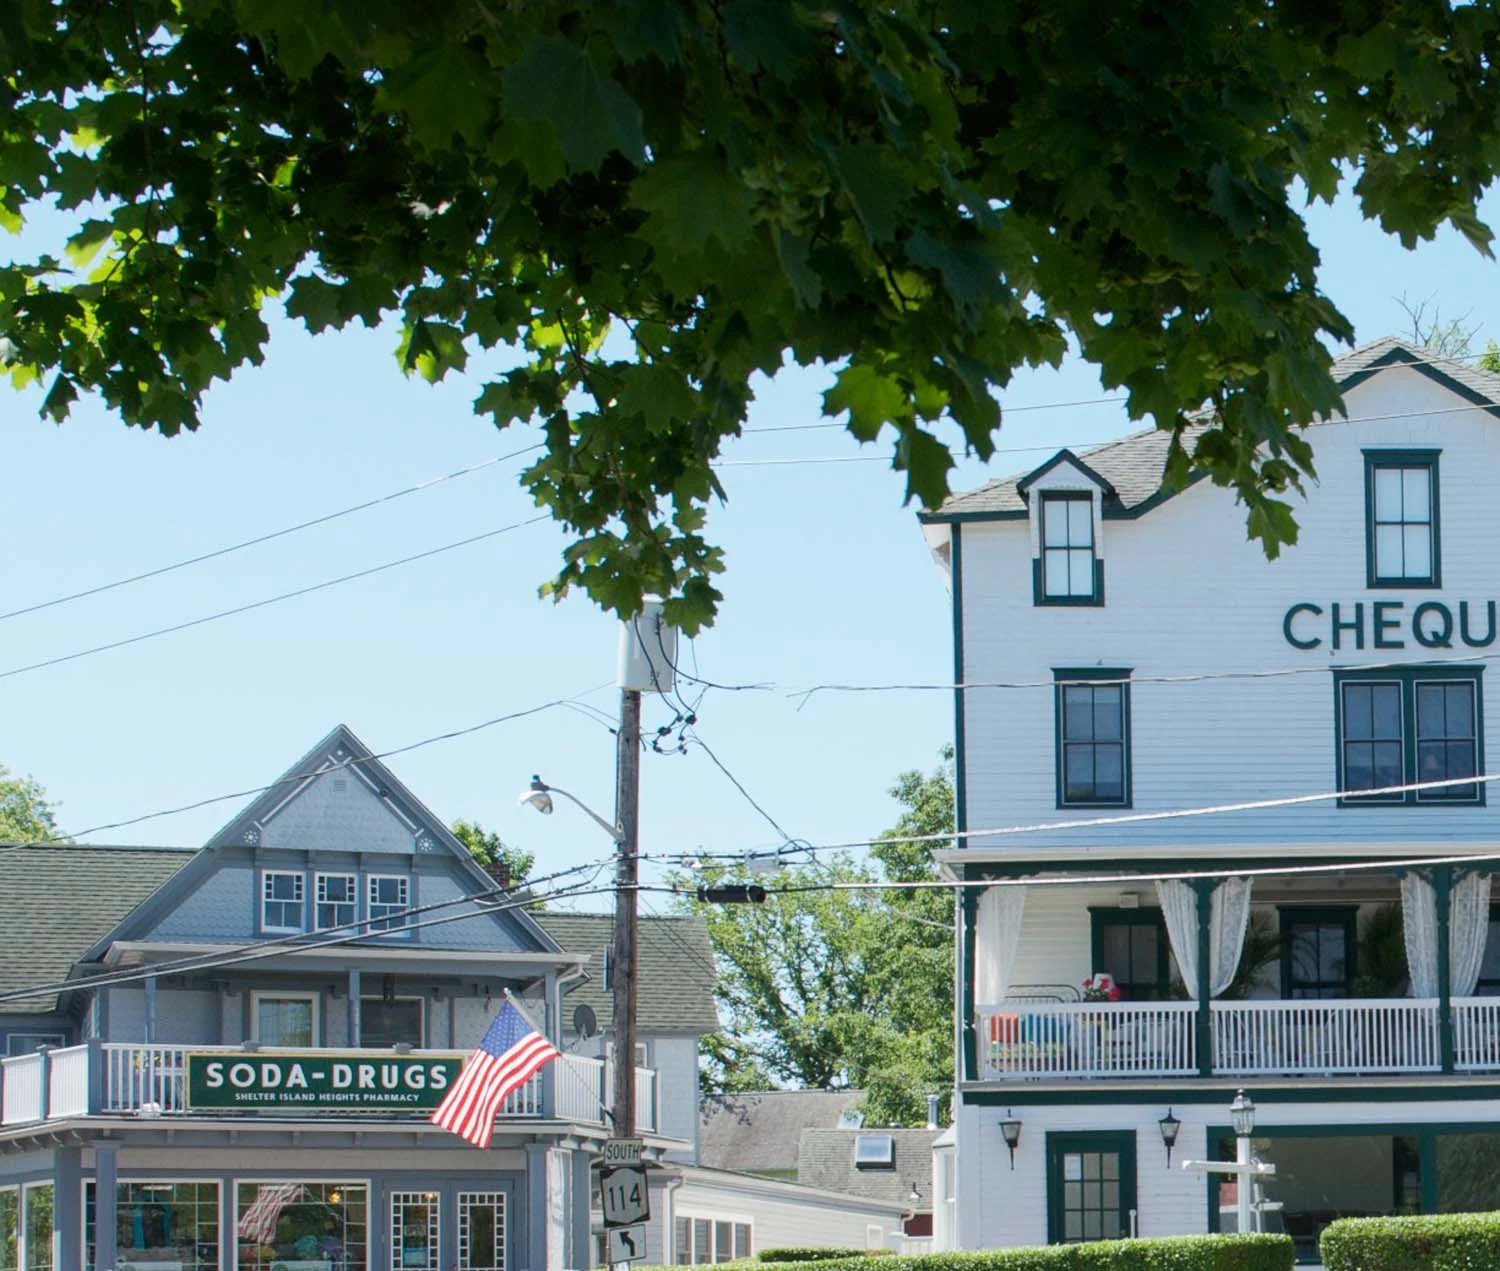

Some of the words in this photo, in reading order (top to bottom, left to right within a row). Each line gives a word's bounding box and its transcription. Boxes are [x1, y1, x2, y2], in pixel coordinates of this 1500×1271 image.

[235, 1093, 276, 1101] SHELTER
[279, 1093, 316, 1101] ISLAND
[319, 1093, 360, 1101] HEIGHTS
[363, 1093, 420, 1102] PHARMACY
[606, 1144, 639, 1159] SOUTH
[609, 1183, 642, 1212] 114
